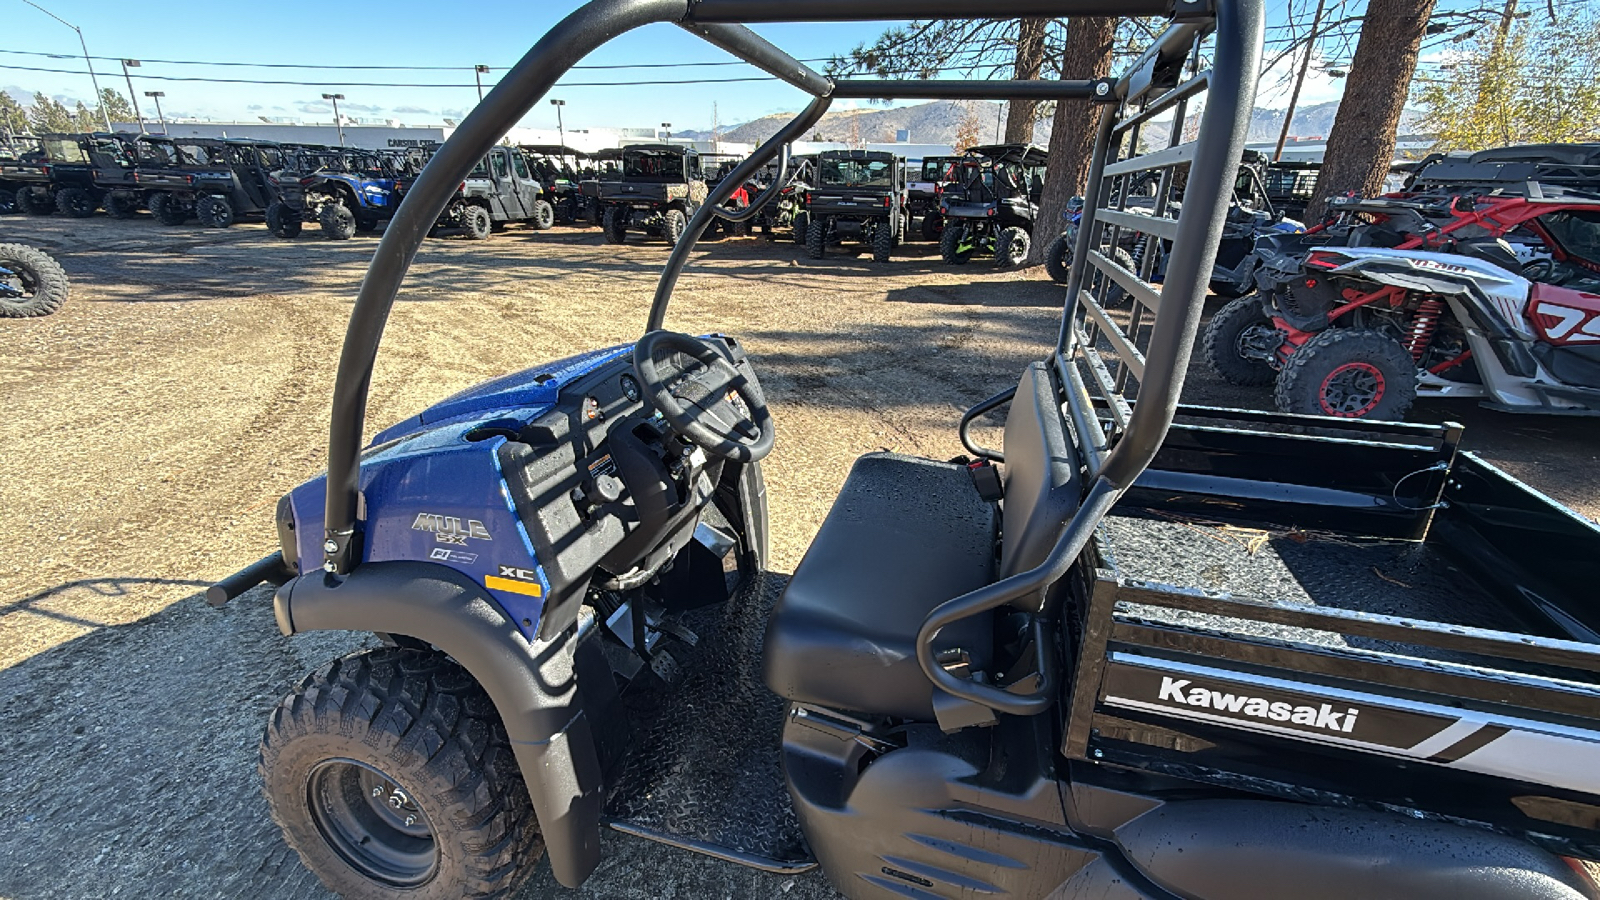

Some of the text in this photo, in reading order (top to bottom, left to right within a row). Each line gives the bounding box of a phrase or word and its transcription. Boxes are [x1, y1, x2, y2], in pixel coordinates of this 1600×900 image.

[387, 139, 418, 147] CARSON
[411, 513, 493, 541] MULE
[499, 566, 534, 581] XC
[1158, 676, 1360, 733] Kawasaki
